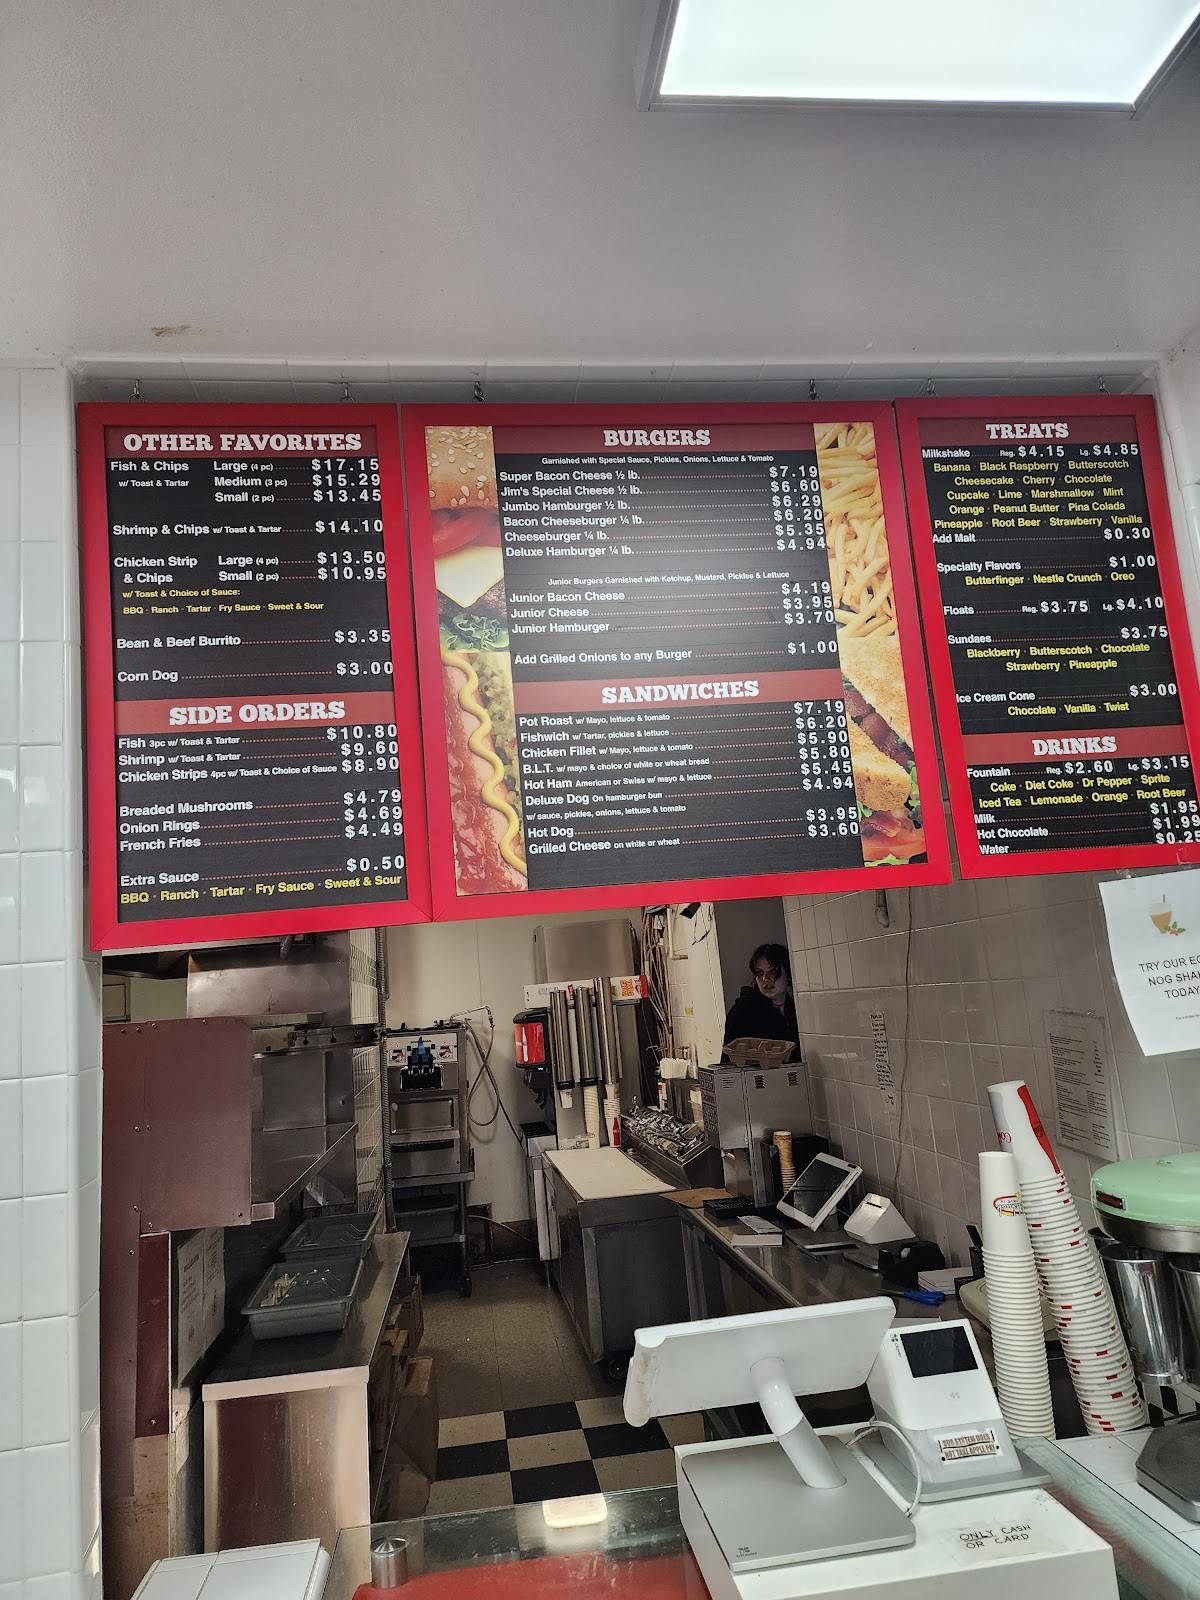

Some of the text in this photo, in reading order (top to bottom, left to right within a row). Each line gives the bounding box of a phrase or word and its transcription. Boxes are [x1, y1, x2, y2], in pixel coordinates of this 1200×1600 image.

[604, 430, 711, 446] BURGERS
[986, 423, 1069, 439] TREATS
[124, 433, 361, 451] OTHER FAVORITES
[922, 449, 970, 458] Milkshake
[1018, 446, 1064, 458] $4.15
[1093, 444, 1138, 456] $4.85
[111, 459, 378, 472] Fish & Chips Large (4 pc) $17.15
[542, 457, 580, 465] Garnished
[599, 456, 625, 464] Special
[627, 456, 652, 464] Sauce,
[654, 456, 681, 464] Pickles,
[683, 455, 710, 463] Onions,
[712, 455, 738, 463] Lettuce
[164, 479, 189, 487] Tartar
[215, 474, 380, 487] Medium (3 pc) $15.29
[500, 466, 818, 483] Super Bacon Cheese $7.19
[955, 474, 1112, 486] Cheesecake Cherry Chocolate
[215, 490, 381, 503] Small (2 pc) $13.45
[501, 481, 819, 497] Jim's Special Cheese $6.60
[502, 495, 821, 512] Jumbo Hamburger $6.29
[949, 505, 984, 515] Orange
[993, 504, 1027, 513] Peanut
[1030, 503, 1060, 512] Butter
[1092, 502, 1125, 511] Colada
[113, 520, 383, 536] Shrimp & Chips $14.10
[506, 538, 826, 558] Deluxe Hamburger $4.94
[937, 555, 1156, 573] Specialty Flavors $1.00
[966, 572, 1135, 586] Butterfinger Nestle Crunch Oreo
[510, 582, 830, 602] Junior Bacon Cheese $4.19
[117, 630, 391, 648] Bean & Beef Burrito $3.35
[514, 641, 837, 664] Add Grilled Onions to any Burger $1.00
[118, 662, 393, 682] Corn Dog $3.00
[602, 681, 760, 704] SANDWICHES
[956, 683, 1177, 703] Ice Cream Cone $3.00
[169, 701, 345, 725] SIDE ORDERS
[519, 701, 844, 727] Pot Roast $7.19
[520, 716, 846, 742] Fishwich $6.20
[522, 731, 847, 758] Chicken Fillet $5.90
[1032, 736, 1117, 756] DRINKS
[523, 747, 849, 774] B.L.T. $5.80
[990, 775, 1170, 792] Coke Diet Coke Dr Pepper Sprite
[120, 790, 401, 817] Breaded Mushrooms $4.79
[120, 807, 402, 834] Onion Rings $4.69
[120, 823, 402, 851] French Fries $4.49
[529, 822, 859, 854] Grilled Cheese $3.60
[977, 828, 1048, 839] Hot Chocolate
[121, 875, 401, 904] BBQ Ranch Tartar Fry Sauce Sweet & Sour
[1138, 961, 1159, 973] TRY
[1164, 958, 1187, 968] OUR
[1148, 971, 1200, 986] NOG SHA
[1164, 986, 1199, 998] TODAY
[960, 1525, 1031, 1541] ONLY CASH
[995, 1534, 1029, 1543] CARD
